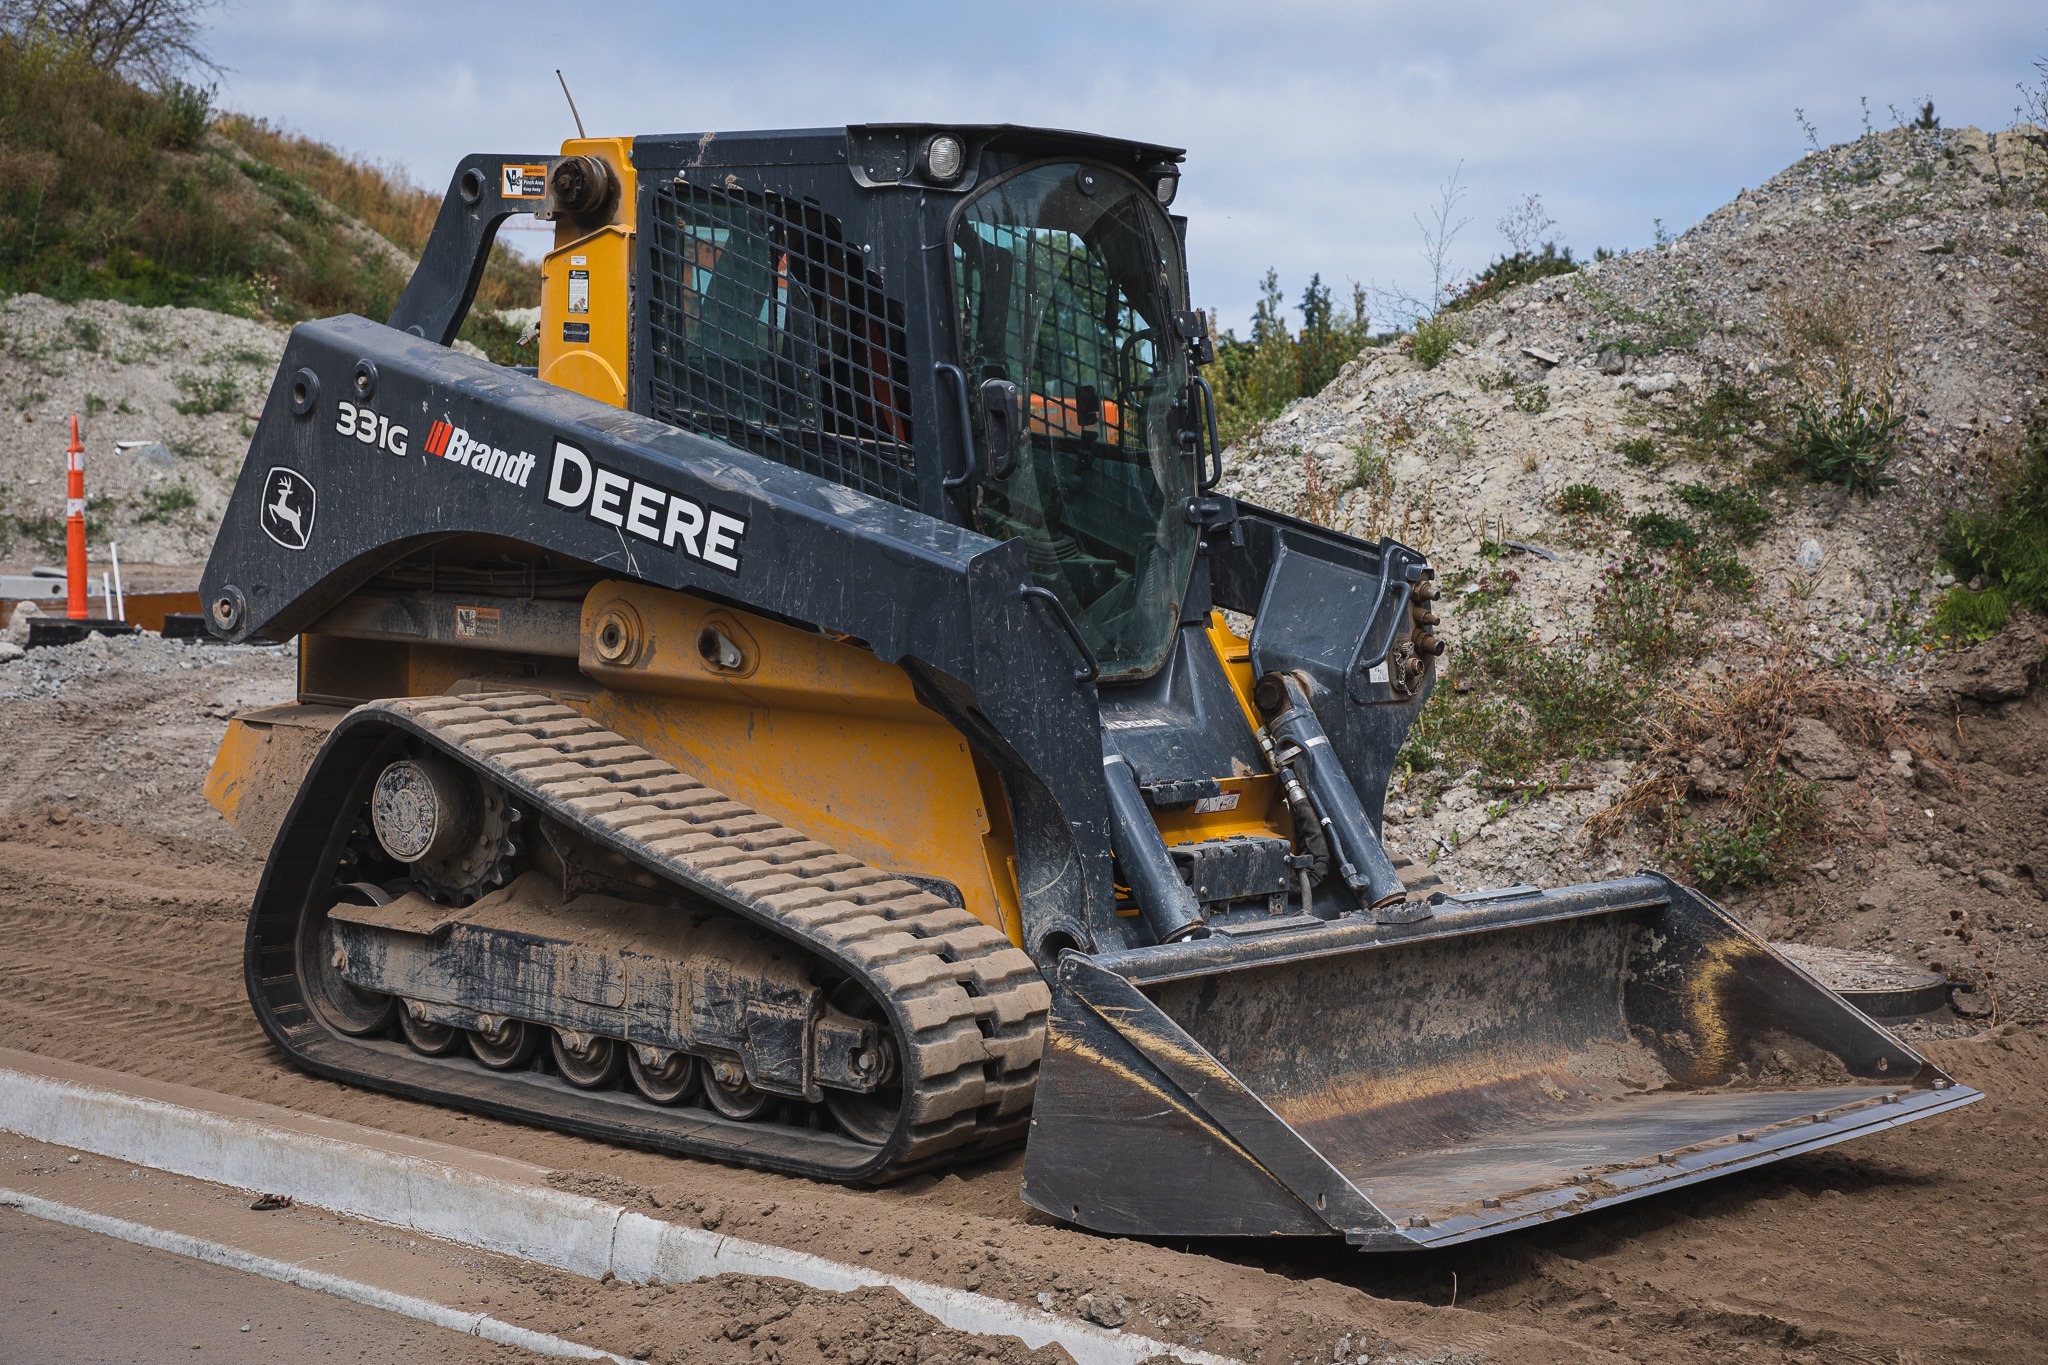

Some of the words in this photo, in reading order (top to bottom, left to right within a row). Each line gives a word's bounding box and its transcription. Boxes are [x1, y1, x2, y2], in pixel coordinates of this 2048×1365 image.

[336, 402, 409, 456] 331G
[444, 427, 536, 488] Brandt
[547, 441, 745, 572] DEERE
